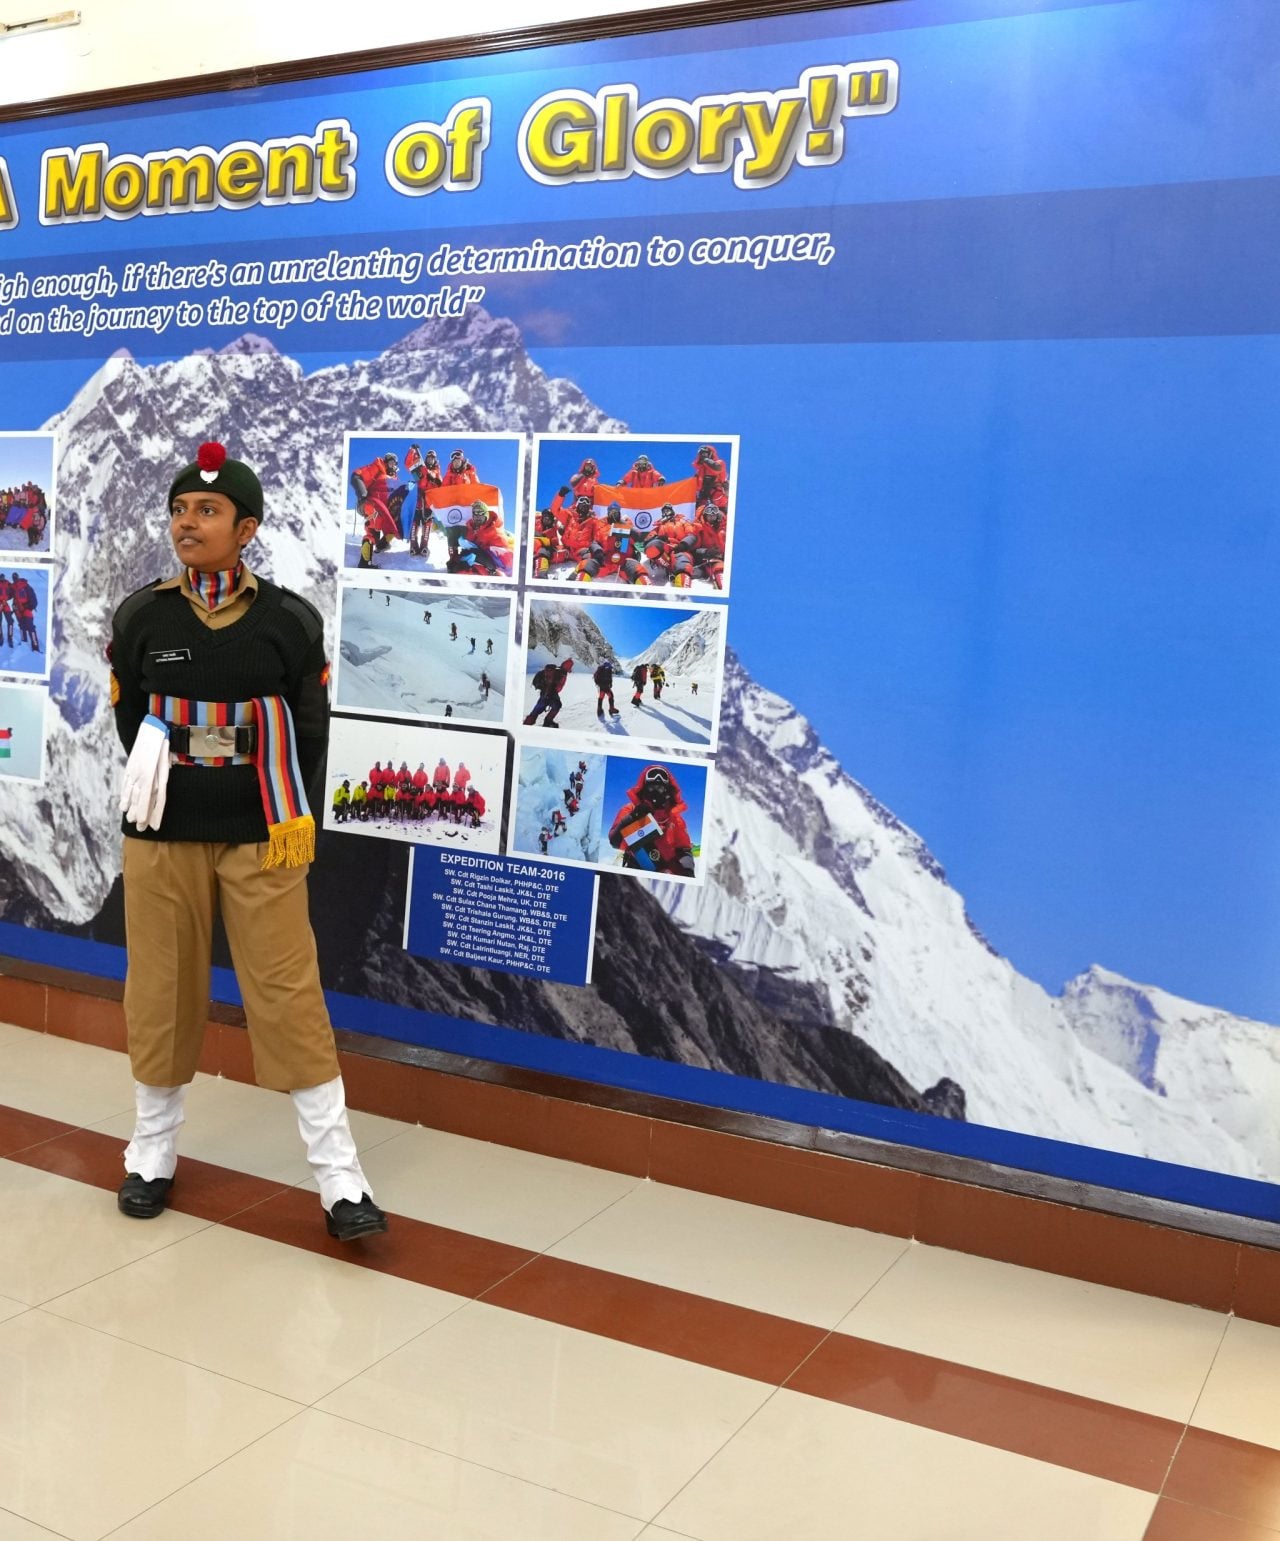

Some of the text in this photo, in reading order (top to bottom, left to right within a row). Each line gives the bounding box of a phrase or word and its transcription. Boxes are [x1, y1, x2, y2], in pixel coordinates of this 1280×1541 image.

[40, 120, 356, 225] Moment
[387, 97, 491, 196] of
[519, 61, 897, 190] Glory!"
[31, 266, 118, 299] enough,
[122, 263, 145, 292] if
[230, 261, 264, 286] an
[268, 247, 423, 284] unrelenting
[427, 235, 641, 276] determination
[647, 235, 685, 266] to
[688, 232, 836, 270] conquer,
[16, 313, 45, 334] on
[48, 305, 84, 331] the
[84, 303, 174, 337] journey
[176, 301, 204, 327] to
[207, 296, 250, 326] the
[254, 297, 298, 330] top
[301, 290, 335, 321] of
[336, 289, 383, 321] the
[440, 853, 565, 881] EXPEDITION TEAM-2016
[457, 870, 469, 878] Cdt
[545, 884, 559, 893] DTE
[464, 880, 475, 888] Cdt
[537, 892, 551, 900] DTE
[445, 895, 457, 903] Cdt
[553, 913, 567, 922] DTE
[466, 889, 478, 898] Cdt
[533, 900, 547, 909] DTE
[454, 905, 466, 913] Cdt
[543, 920, 556, 929] DTE
[458, 914, 469, 923] Cdt
[537, 928, 551, 937] DTE
[456, 923, 467, 931] Cdt
[538, 937, 552, 946] DTE
[460, 933, 472, 941] Cdt
[532, 945, 546, 954] DTE
[453, 949, 464, 957] Cdt
[536, 964, 550, 973] DTE
[460, 941, 471, 949] Cdt
[531, 954, 545, 963] DTE
